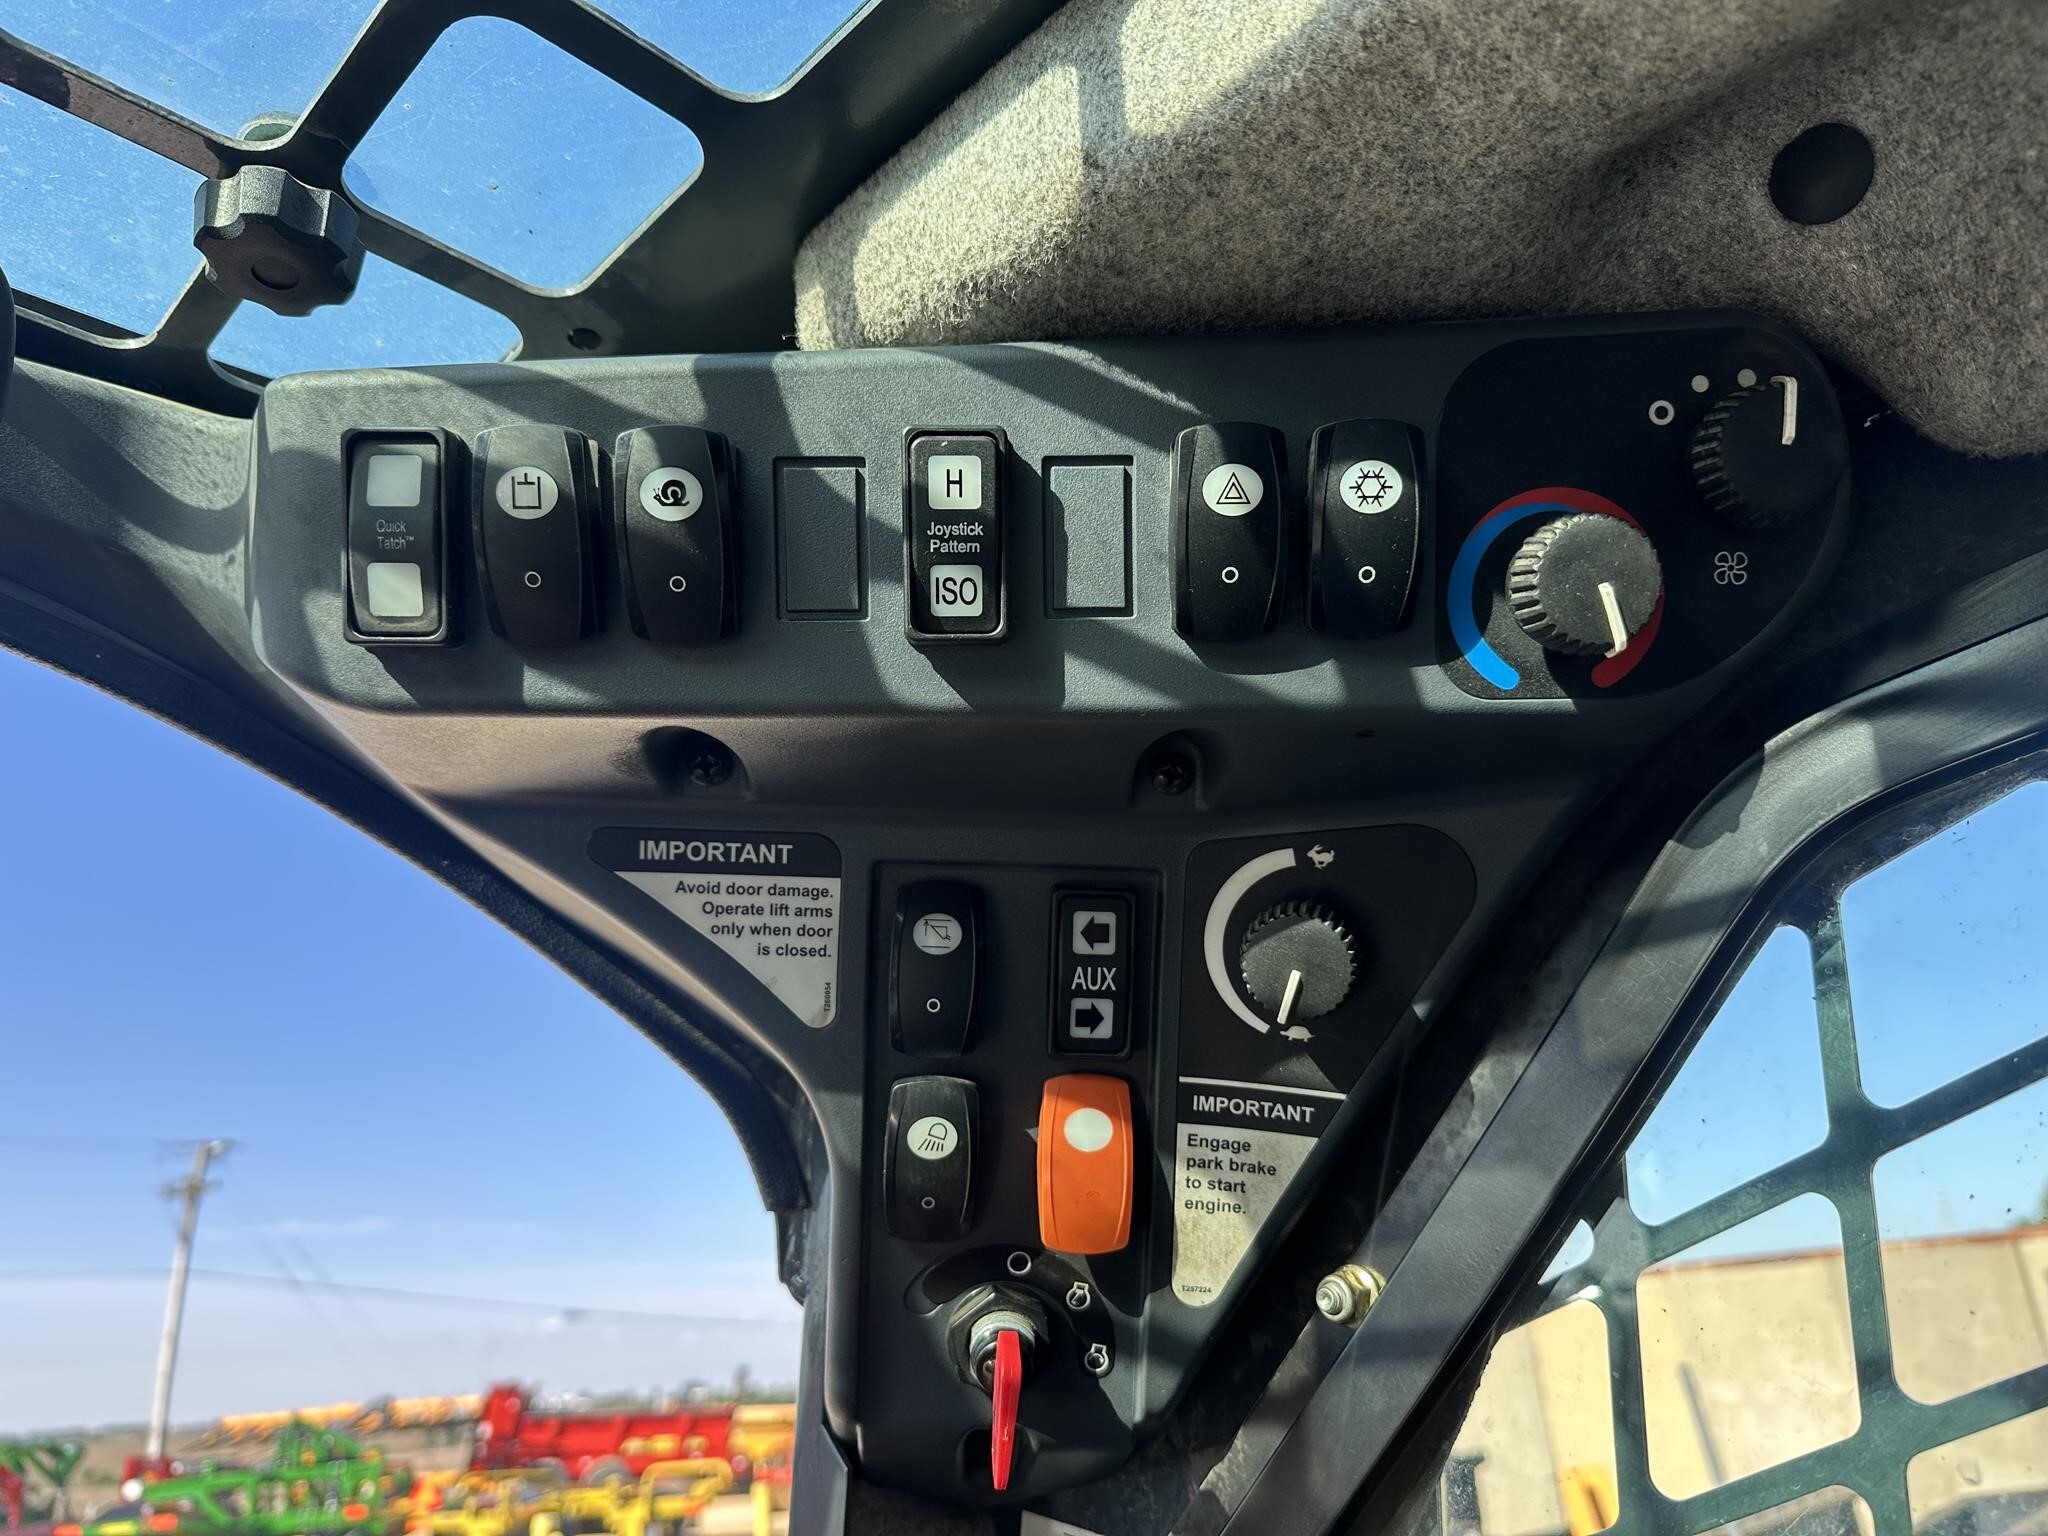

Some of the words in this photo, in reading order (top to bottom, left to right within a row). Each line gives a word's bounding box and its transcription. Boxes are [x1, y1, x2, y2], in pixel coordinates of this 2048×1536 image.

[946, 469, 962, 498] H
[376, 520, 407, 533] Quick
[927, 522, 984, 539] Joystick
[930, 539, 980, 553] Pattern
[935, 576, 978, 605] ISO
[639, 840, 793, 865] IMPORTANT
[675, 881, 720, 894] Avoid
[726, 882, 762, 896] door
[767, 884, 833, 900] damage.
[703, 901, 764, 917] Operate
[770, 904, 789, 916] lift
[794, 907, 833, 918] arms
[711, 922, 744, 938] only
[750, 923, 791, 936] when
[797, 924, 833, 937] door
[757, 943, 770, 956] is
[776, 944, 832, 957] closed.
[1071, 966, 1116, 991] AUX
[1193, 1095, 1315, 1123] IMPORTANT
[1187, 1133, 1251, 1152] Engage
[1186, 1157, 1223, 1171] park
[1229, 1158, 1277, 1176] brake
[1186, 1176, 1201, 1189] to
[1207, 1179, 1246, 1193] start
[1184, 1198, 1246, 1215] engine.
